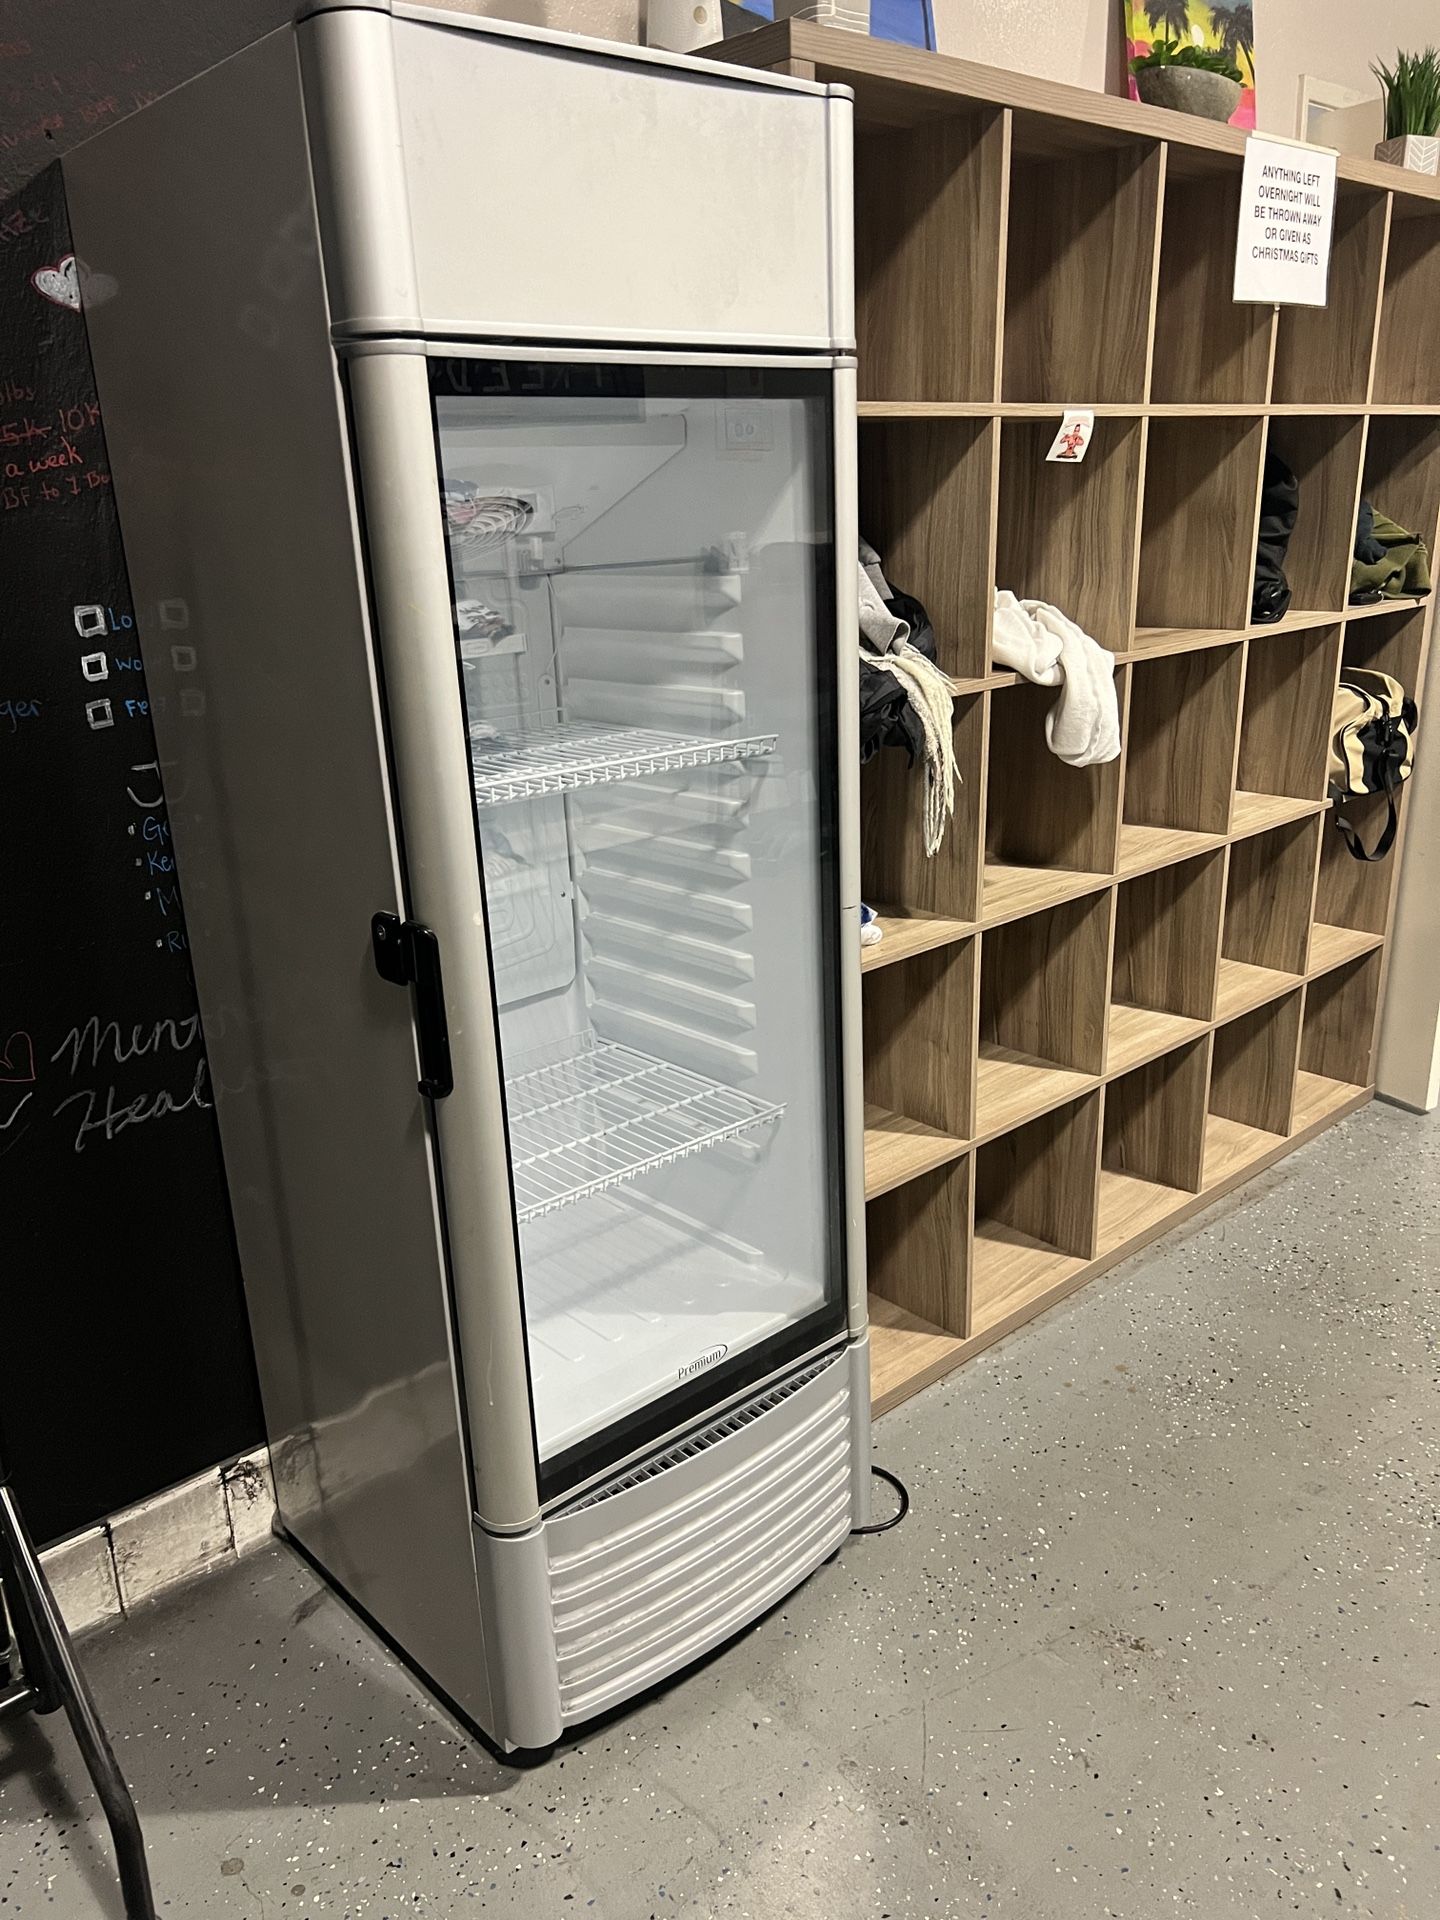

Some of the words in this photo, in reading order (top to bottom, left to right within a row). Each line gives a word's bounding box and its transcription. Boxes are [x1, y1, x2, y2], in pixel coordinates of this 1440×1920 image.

[1262, 165, 1301, 184] ANYTHING
[1303, 173, 1320, 188] LEFT
[1258, 185, 1302, 204] OVERNIGHT
[1304, 193, 1321, 208] WILL
[1254, 205, 1266, 219] BE
[1268, 207, 1301, 224] THROWN
[1302, 213, 1322, 228] AWAY
[1265, 227, 1277, 241] OR
[1279, 228, 1301, 243] GIVEN
[1302, 233, 1311, 245] AS
[1252, 246, 1299, 263] CHRISTMAS
[1300, 252, 1319, 266] GIFTS
[5, 463, 25, 478] a
[28, 436, 84, 473] week
[40, 481, 60, 501] to
[678, 1349, 722, 1379] Premium
